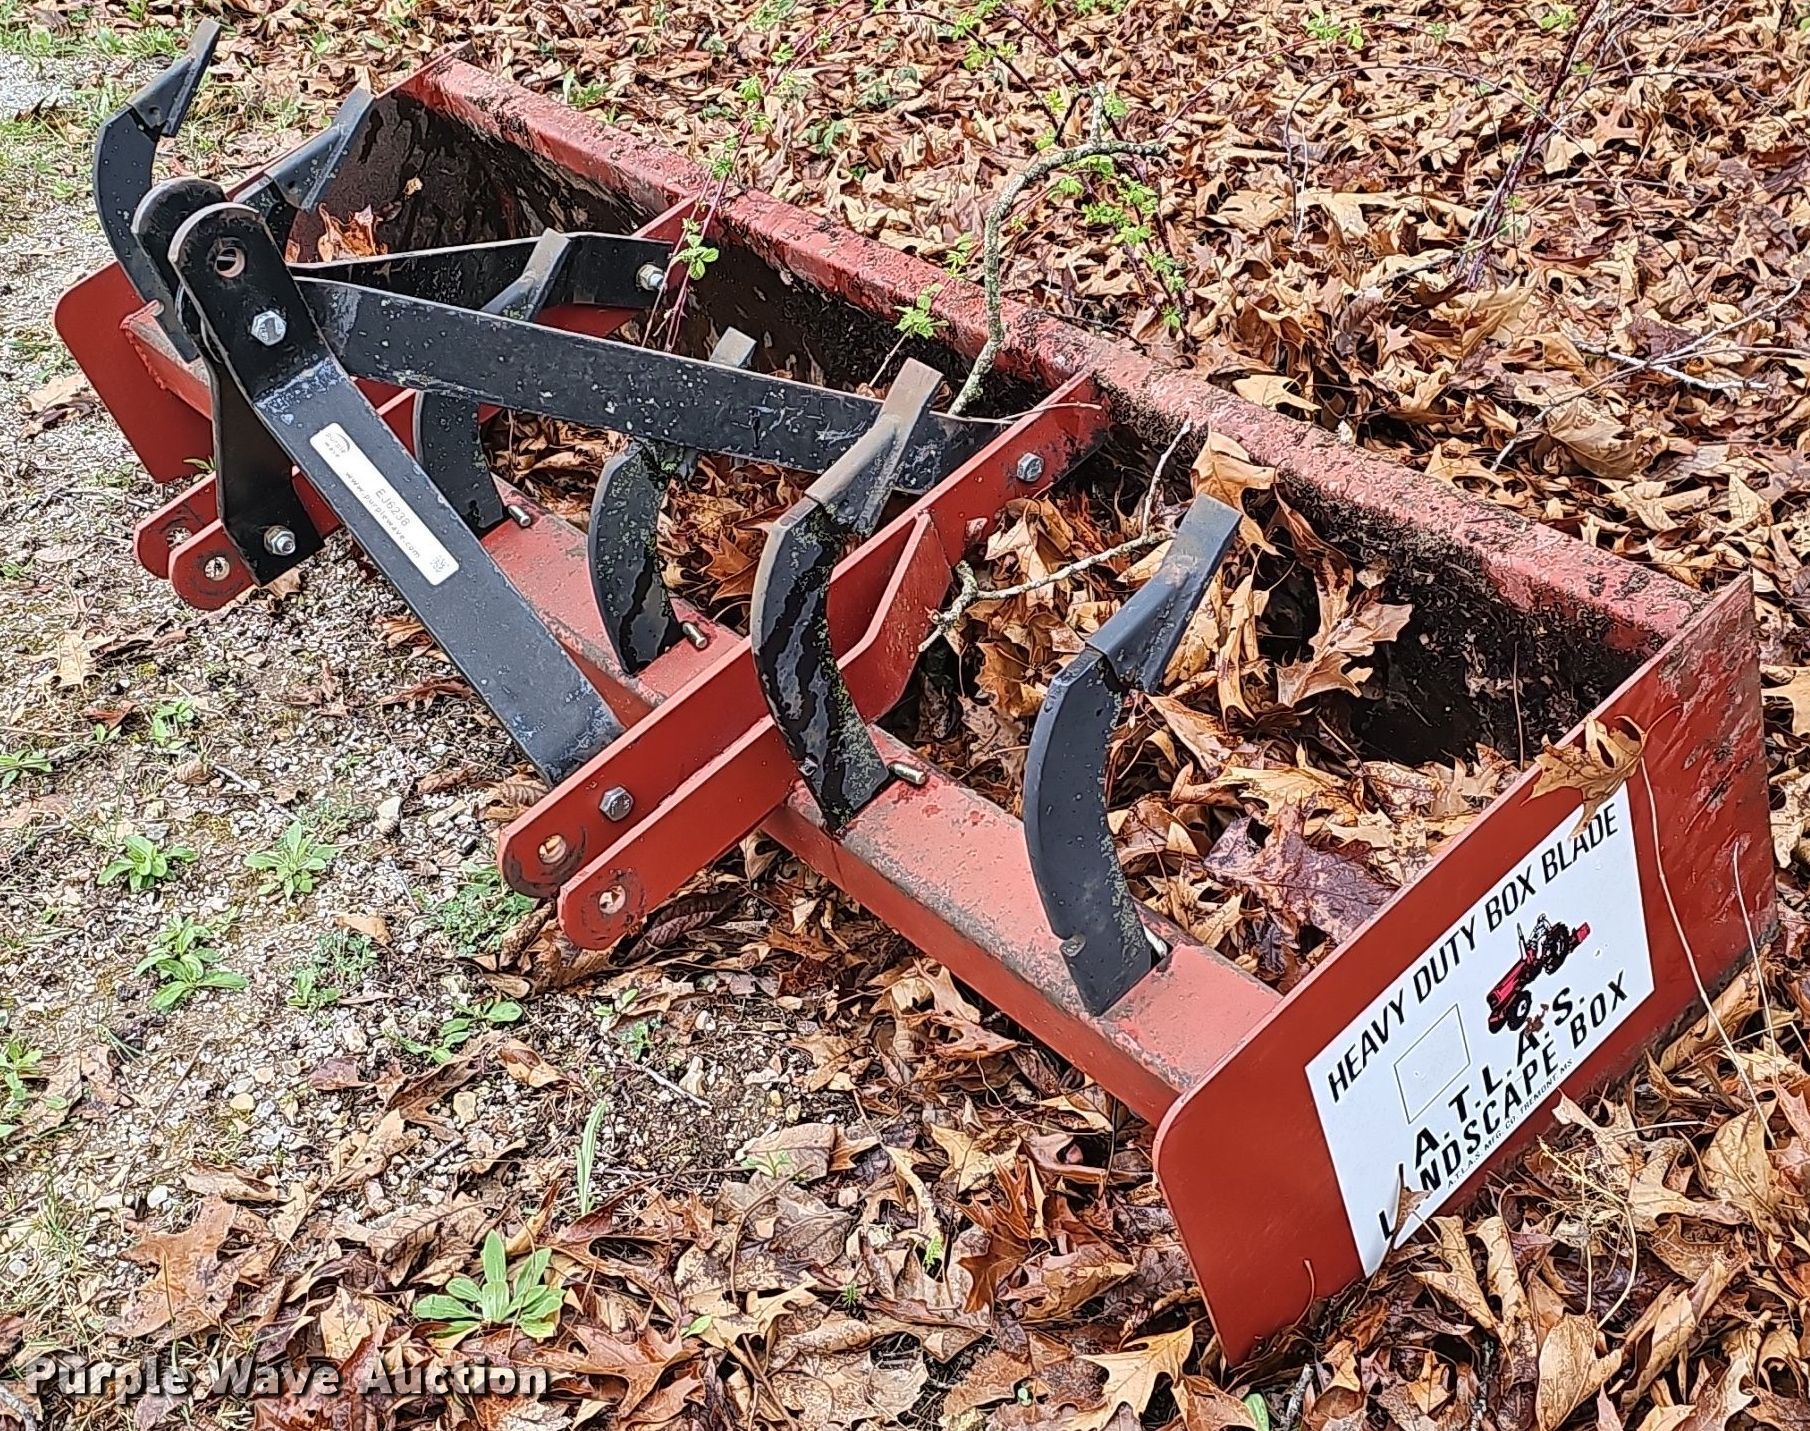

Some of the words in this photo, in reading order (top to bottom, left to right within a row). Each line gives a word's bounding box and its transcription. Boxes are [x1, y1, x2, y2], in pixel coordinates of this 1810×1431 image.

[346, 472, 420, 558] www.purplewave.com
[1327, 988, 1405, 1103] HEAVY
[1412, 914, 1478, 1004] DUTY
[1484, 865, 1537, 933] BOX
[1541, 803, 1619, 885] BLADE
[1378, 1041, 1560, 1242] LNDSCAPE
[1572, 970, 1629, 1052] BOX
[1413, 986, 1587, 1169] A.T.L.A.S.
